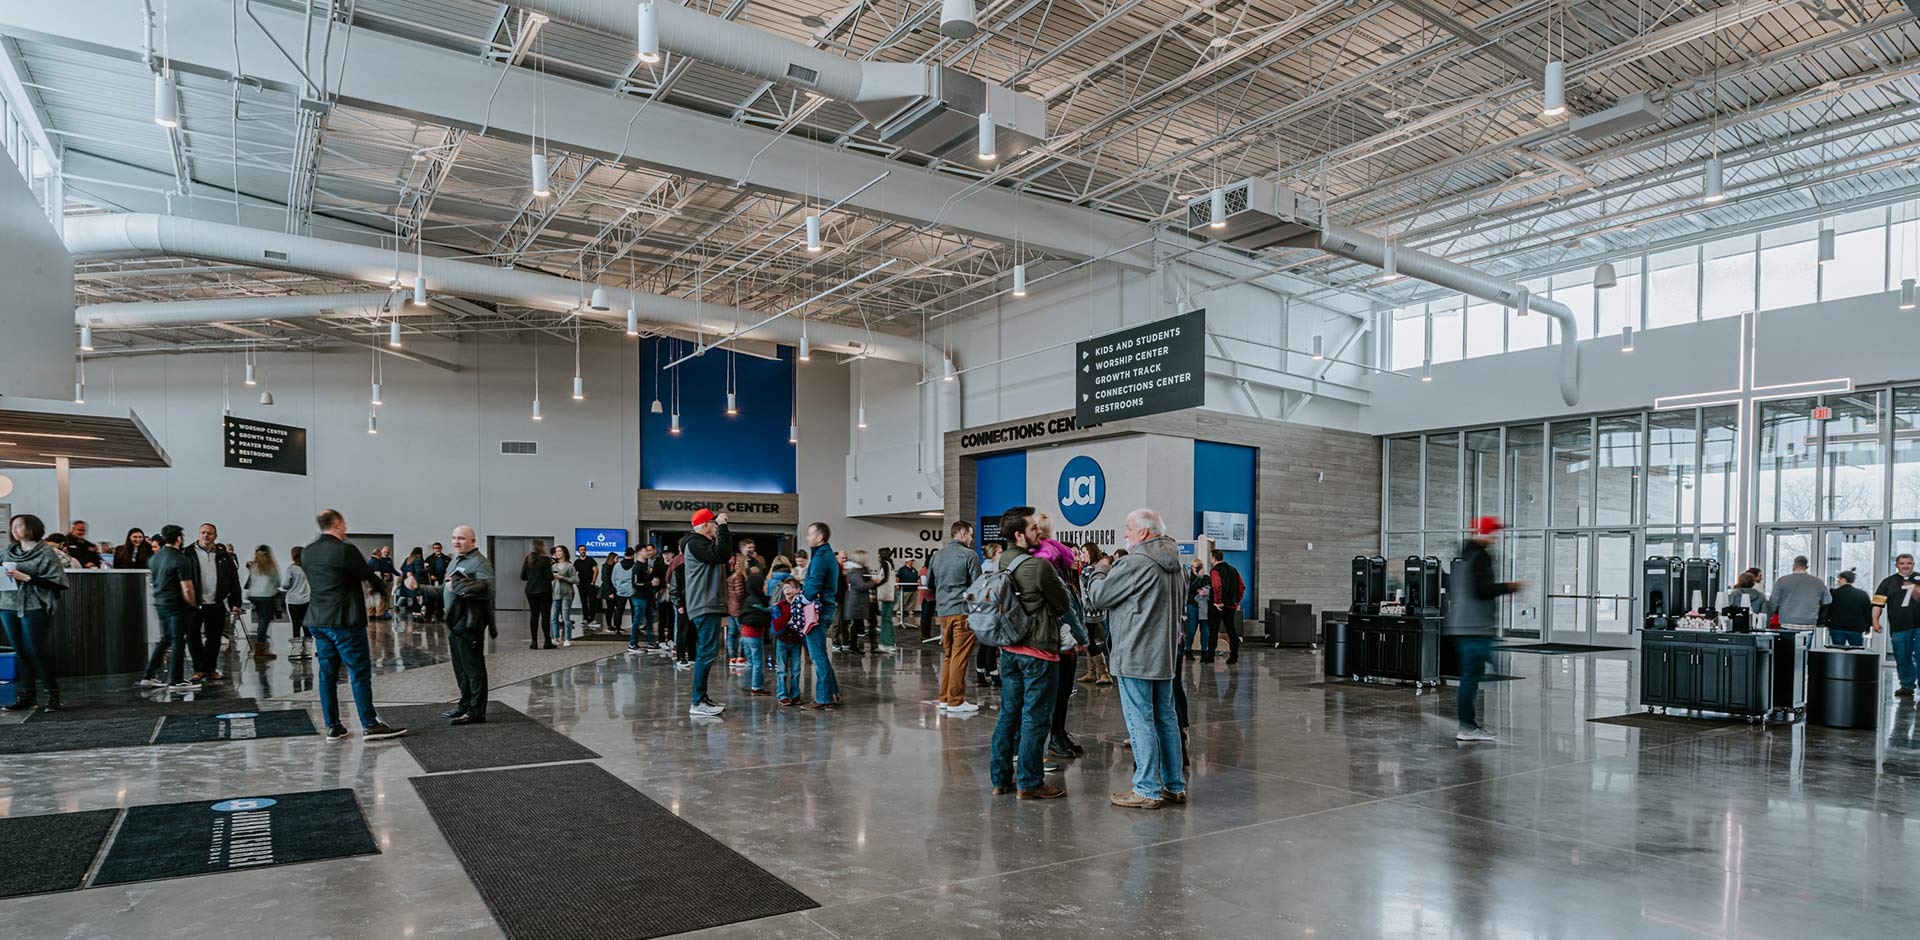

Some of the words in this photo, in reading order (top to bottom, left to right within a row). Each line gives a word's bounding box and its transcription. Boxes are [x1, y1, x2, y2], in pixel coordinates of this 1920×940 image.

[1095, 345, 1114, 356] KIDS
[1116, 340, 1134, 352] AND
[1136, 327, 1181, 346] STUDENTS
[1095, 354, 1133, 370] WORSHIP
[1135, 346, 1169, 361] CENTER
[1095, 370, 1131, 385] GROWTH
[1133, 363, 1161, 377] TRACK
[1095, 380, 1154, 399] CONNECTIONS
[1156, 372, 1191, 387] CENTER
[1095, 398, 1144, 414] RESTROOMS
[1813, 407, 1829, 419] EXIT
[239, 432, 265, 440] GROWTH
[961, 421, 1045, 448] CONNECTIONS
[239, 450, 273, 458] RESTROOMS
[1061, 475, 1096, 506] JCI
[660, 500, 724, 511] WORSHIP
[726, 502, 780, 513] CENTER
[1085, 530, 1115, 545] CHURCH
[1901, 583, 1916, 608] 7
[208, 817, 225, 865] INTERNATIONAL
